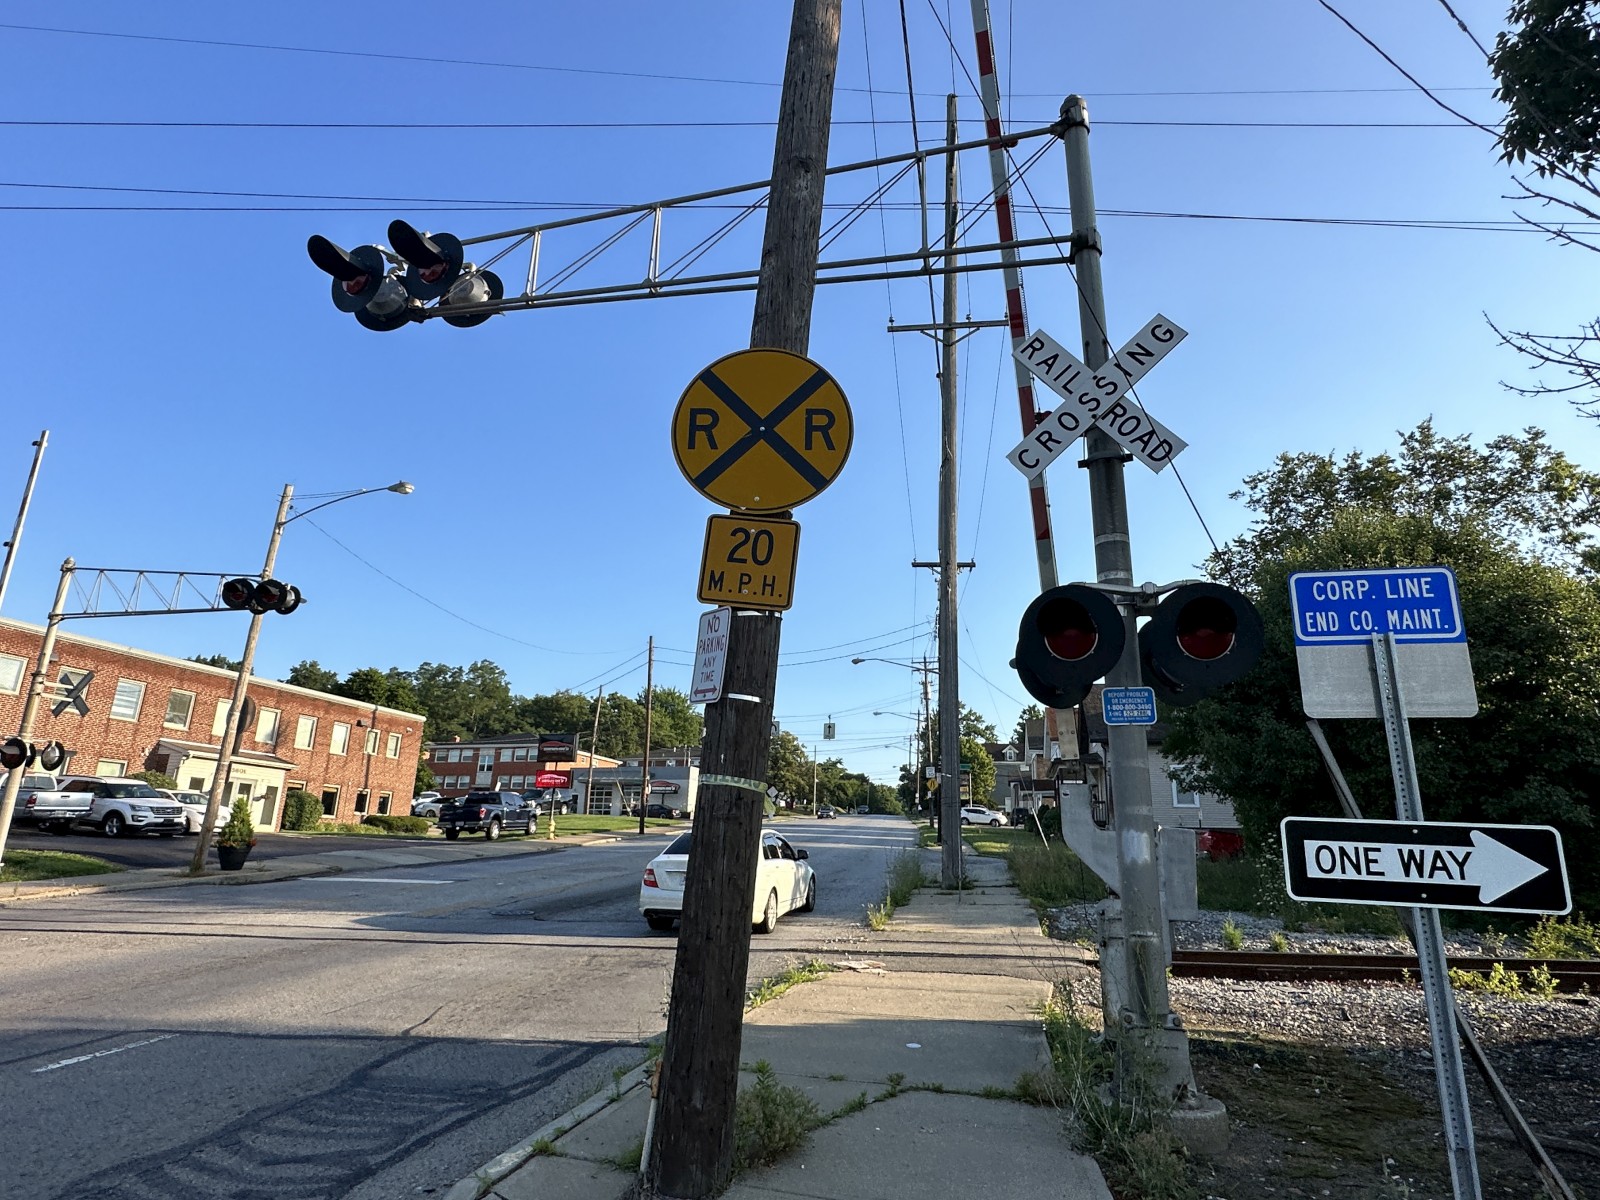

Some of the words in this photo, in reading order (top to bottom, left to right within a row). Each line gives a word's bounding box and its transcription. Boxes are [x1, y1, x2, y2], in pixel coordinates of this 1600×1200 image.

[1018, 324, 1174, 469] CROSSING
[1020, 337, 1080, 395] RAIL
[1102, 402, 1173, 462] ROAD
[687, 407, 720, 450] R
[804, 408, 836, 451] R
[727, 527, 774, 566] 20
[708, 569, 783, 598] M.P.H.
[1312, 579, 1376, 601] CORP.
[1384, 577, 1435, 599] LINE
[707, 616, 720, 634] NO
[1305, 611, 1339, 632] END
[1350, 610, 1379, 631] CO.
[1387, 608, 1449, 630] MAINT.
[698, 636, 725, 655] PARKING
[703, 656, 716, 668] ANY
[701, 671, 715, 683] TIME
[1314, 844, 1385, 877] ONE
[1397, 848, 1472, 881] WAY
